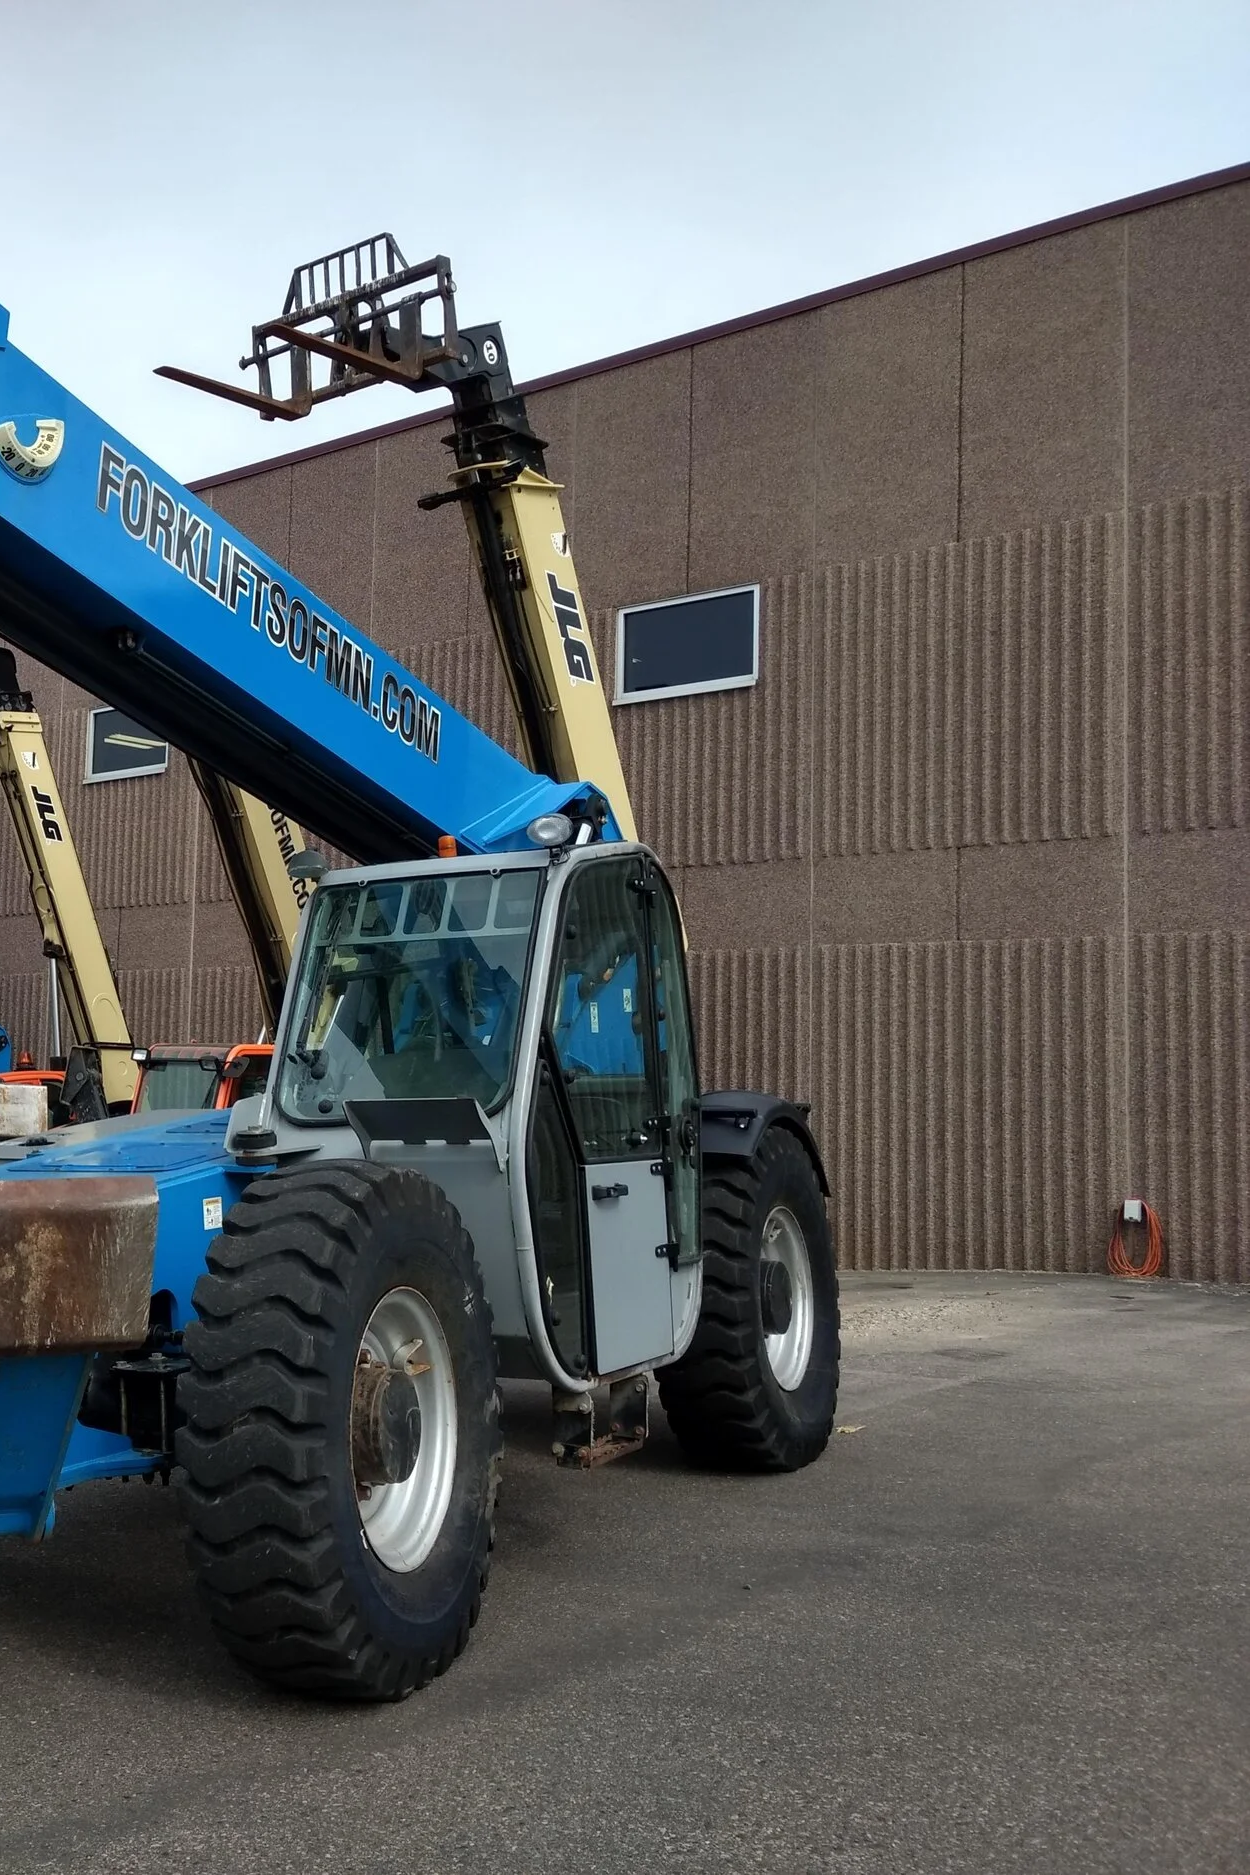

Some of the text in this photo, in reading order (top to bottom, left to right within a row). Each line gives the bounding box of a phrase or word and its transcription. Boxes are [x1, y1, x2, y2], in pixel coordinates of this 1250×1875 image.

[1, 446, 16, 461] -20
[14, 462, 25, 472] 0
[96, 440, 441, 765] FORKLIFTSOFMN.COM
[544, 569, 595, 685] JLG
[29, 784, 64, 842] JLG
